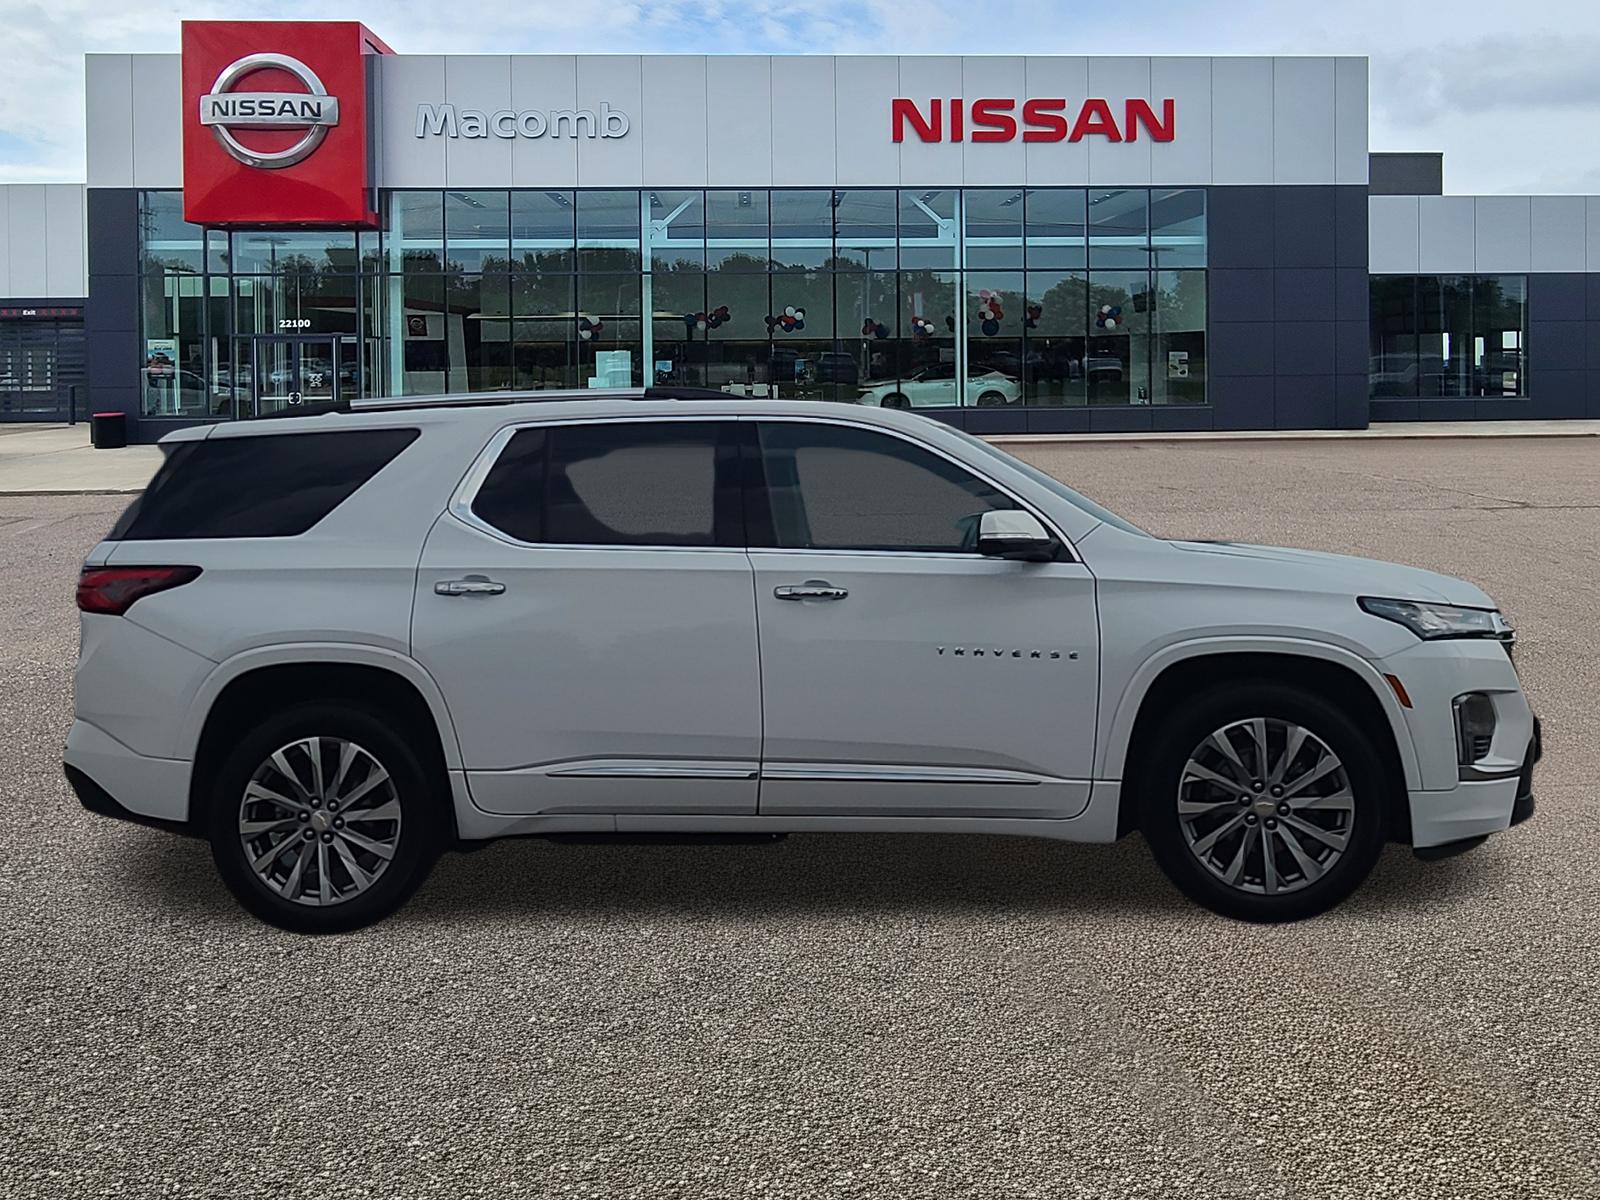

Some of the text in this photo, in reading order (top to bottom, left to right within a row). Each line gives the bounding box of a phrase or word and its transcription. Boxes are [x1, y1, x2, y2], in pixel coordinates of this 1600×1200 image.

[212, 100, 322, 118] NISSAN
[415, 102, 630, 139] Macomb
[892, 98, 1175, 143] NISSAN
[279, 319, 311, 328] 22100
[936, 646, 1079, 660] TRAVERSE
